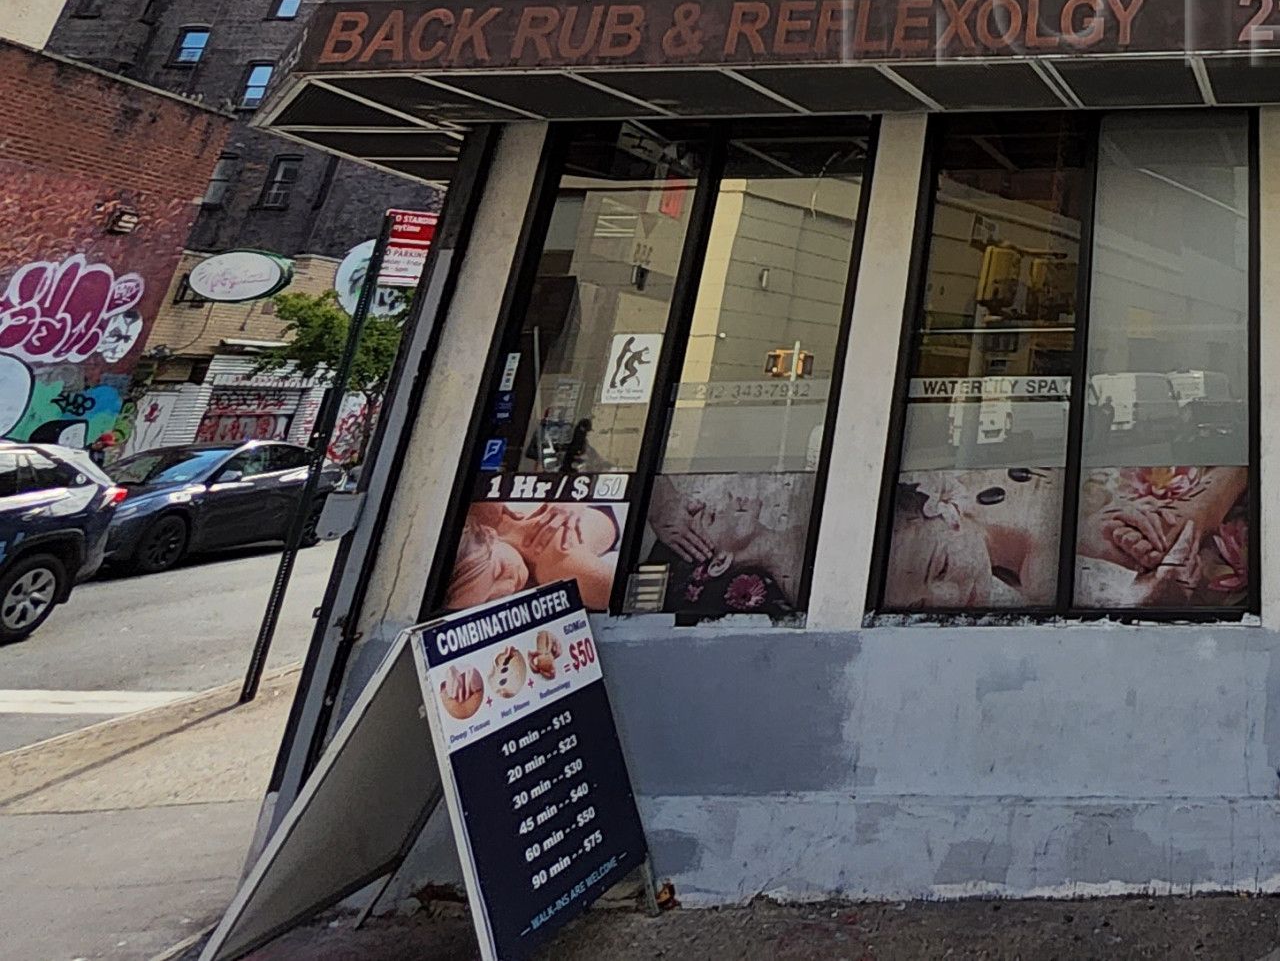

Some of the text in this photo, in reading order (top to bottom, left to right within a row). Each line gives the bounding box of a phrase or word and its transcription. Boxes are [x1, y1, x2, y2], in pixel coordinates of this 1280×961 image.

[319, 7, 501, 64] BACK
[510, 4, 647, 59] RUB
[662, 2, 703, 57] &
[923, 380, 1059, 395] WATERLILY SPA
[487, 475, 503, 498] 1
[510, 475, 552, 498] Hr
[436, 589, 571, 656] COMBINATION OFFER
[569, 637, 595, 673] $50
[502, 710, 572, 756] 10 min $13
[507, 734, 578, 784] 20 min $23
[512, 758, 583, 810] 30 min $30
[519, 782, 589, 835] 45 min $40
[525, 806, 596, 862] 60 min $50
[531, 829, 603, 889] 90 min $75
[530, 856, 619, 931] WALK-INS ARE WELCOME
